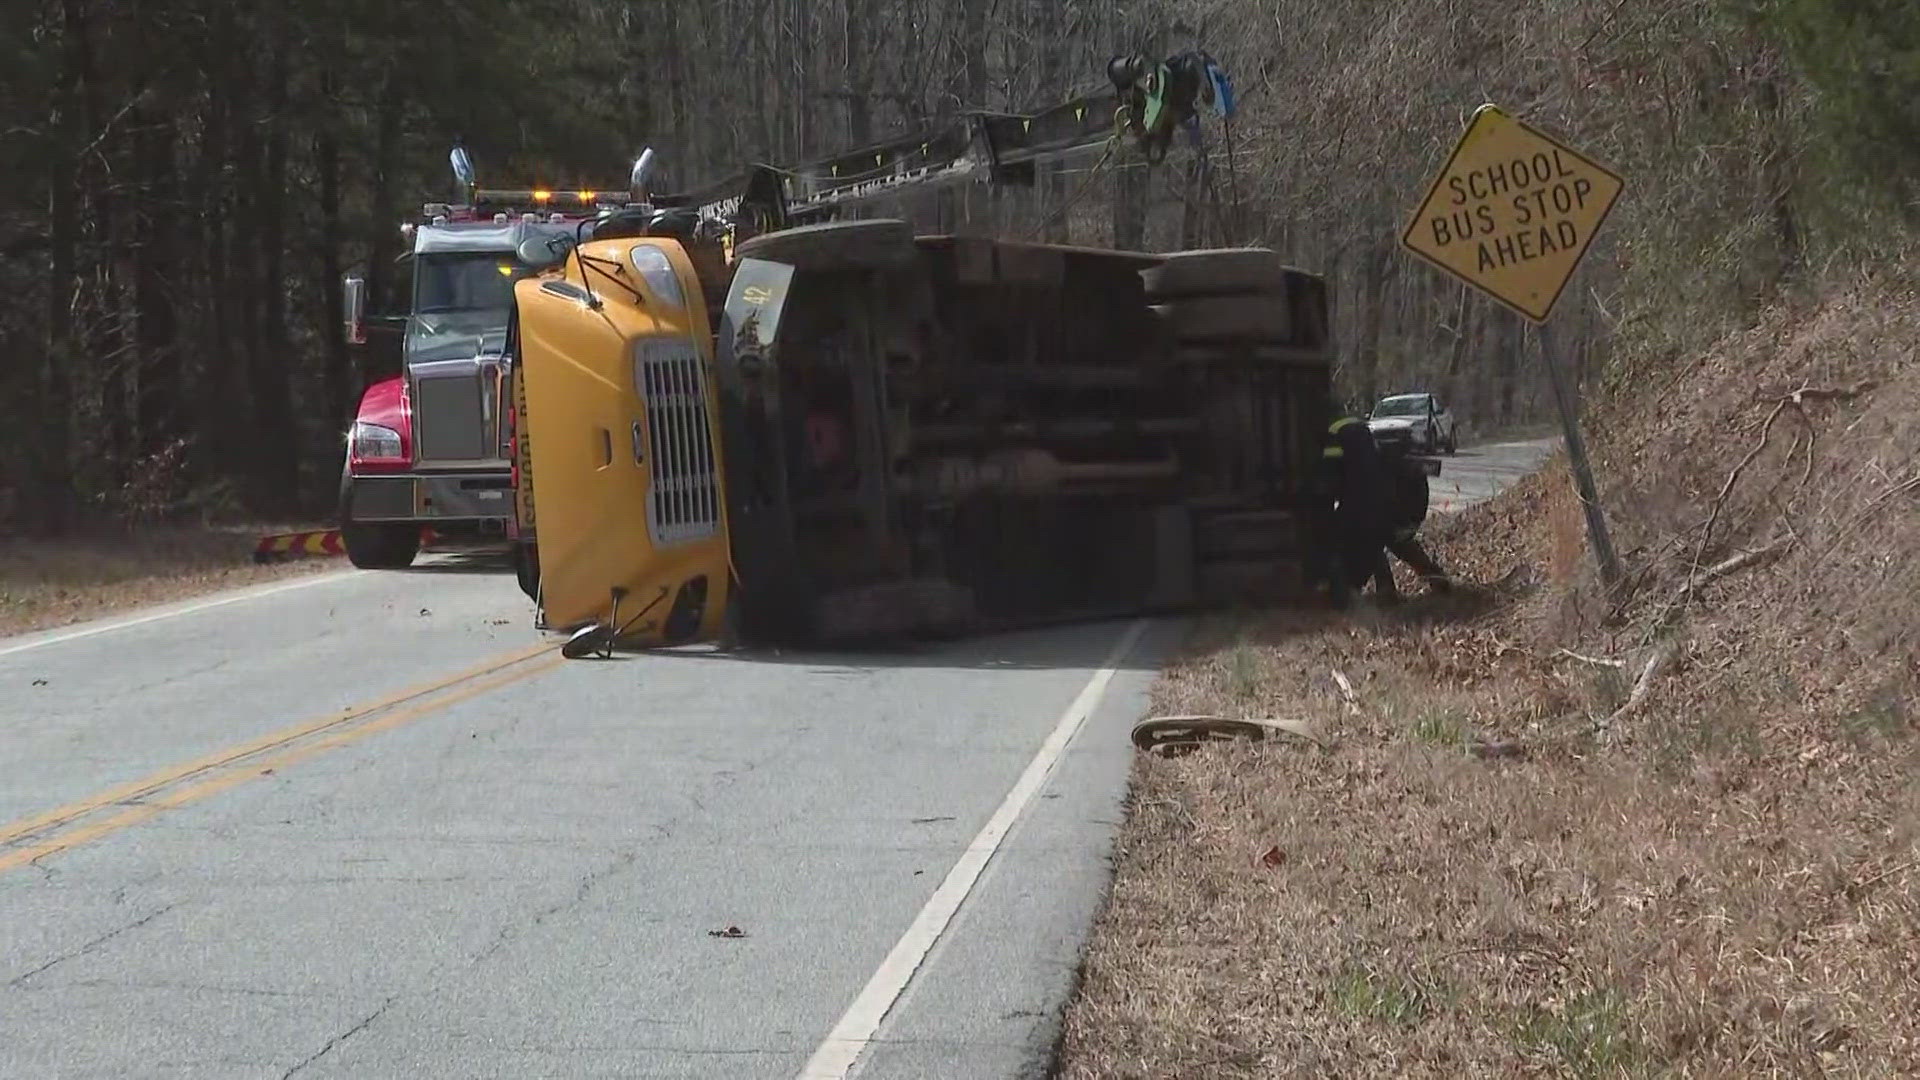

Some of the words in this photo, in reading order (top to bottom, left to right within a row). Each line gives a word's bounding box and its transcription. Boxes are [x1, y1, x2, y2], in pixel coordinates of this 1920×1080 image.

[1450, 150, 1574, 205] SCHOOL
[1431, 205, 1495, 247] BUS
[1513, 178, 1591, 225] STOP
[1477, 220, 1577, 273] AHEAD
[743, 286, 772, 305] 42
